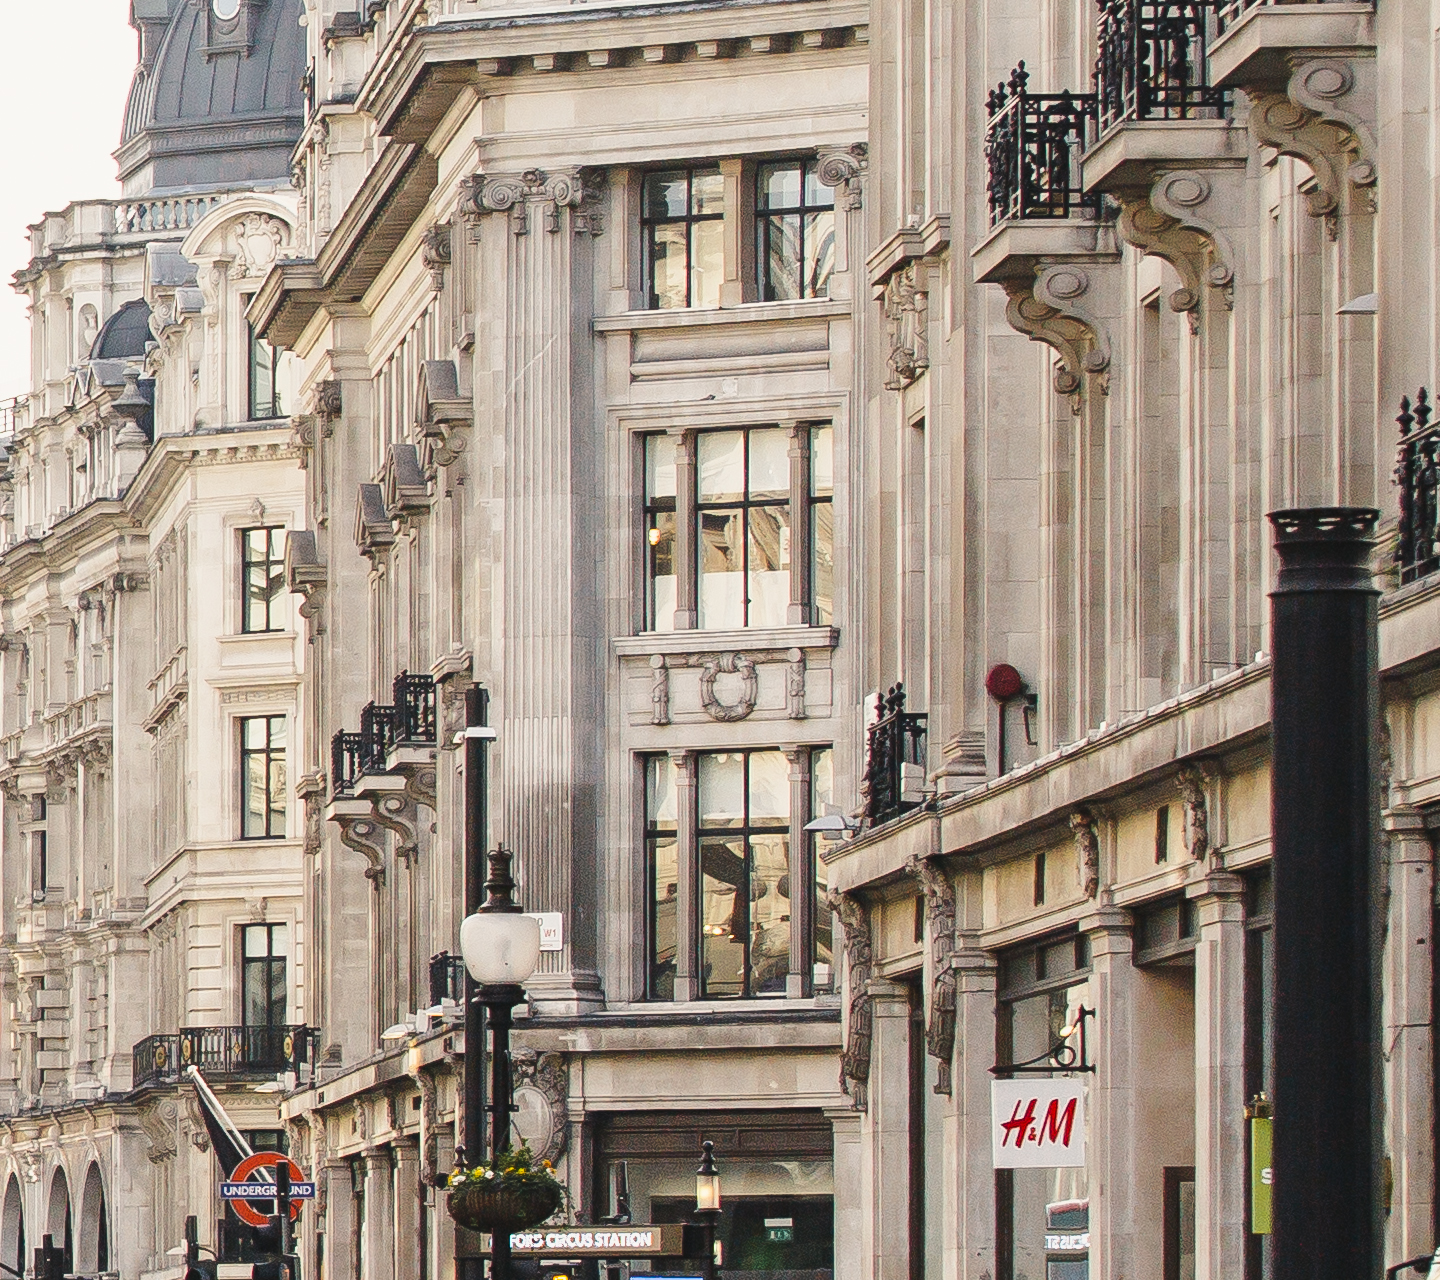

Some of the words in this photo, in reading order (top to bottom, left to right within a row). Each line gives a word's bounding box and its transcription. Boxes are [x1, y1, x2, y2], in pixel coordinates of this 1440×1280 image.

[1000, 1097, 1078, 1149] H&M
[223, 1185, 312, 1196] UNDERGRUND
[546, 1232, 594, 1249] CIRCUS
[595, 1231, 653, 1248] STATION
